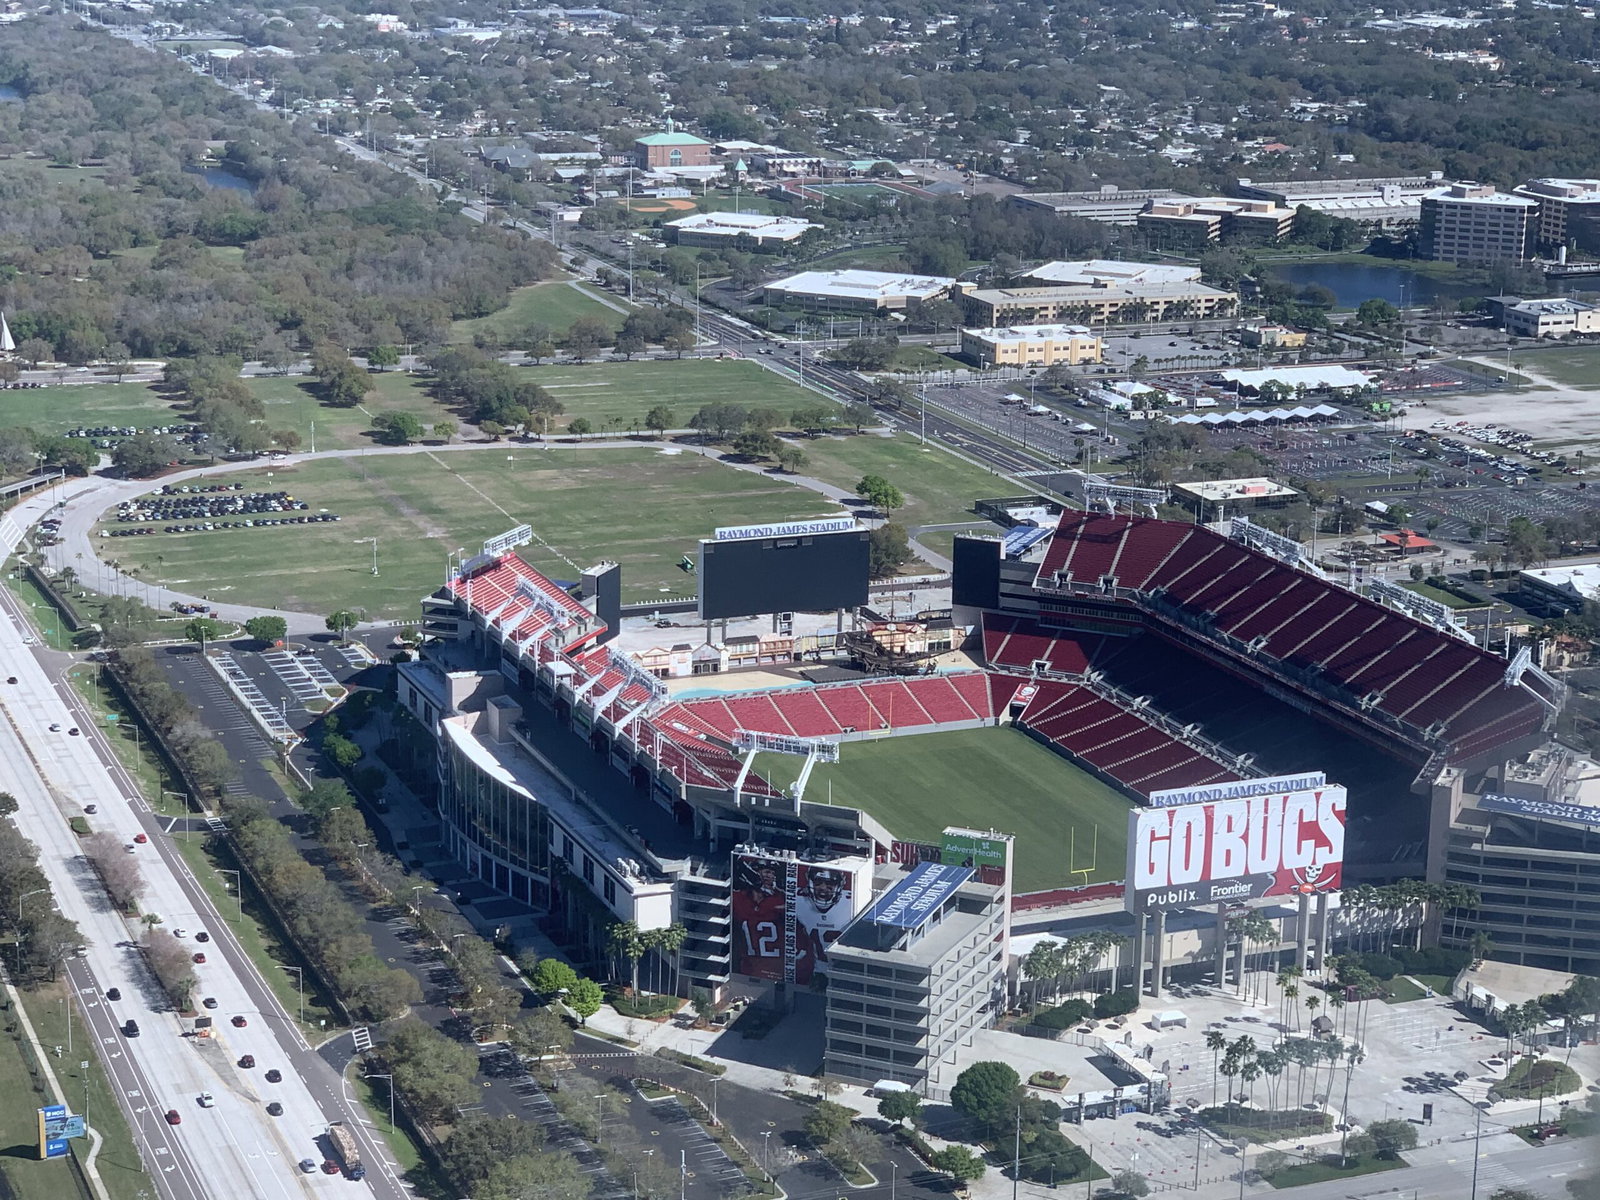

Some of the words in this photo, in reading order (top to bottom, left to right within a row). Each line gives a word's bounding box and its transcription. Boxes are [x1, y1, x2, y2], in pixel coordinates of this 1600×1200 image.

[719, 527, 773, 540] RAYMOND
[773, 524, 808, 536] JAMES
[809, 520, 853, 533] STADIUM
[1155, 790, 1222, 807] RAYMOND
[1223, 783, 1267, 799] JAMES
[1268, 776, 1324, 792] STADIUM
[1485, 794, 1581, 811] RAYMOND
[1135, 810, 1205, 890] GO
[1211, 787, 1346, 880] BUCS
[945, 843, 1002, 859] AdventHealth
[786, 881, 796, 900] FLAGS
[876, 886, 923, 922] RAYMOND
[914, 863, 947, 887] JAMES
[910, 880, 952, 911] STADIUM
[1147, 889, 1195, 907] Publix
[1210, 883, 1253, 896] Frontier
[786, 901, 795, 913] THE
[786, 914, 795, 932] RAISE
[742, 920, 780, 957] 12
[786, 935, 795, 955] FLAGS
